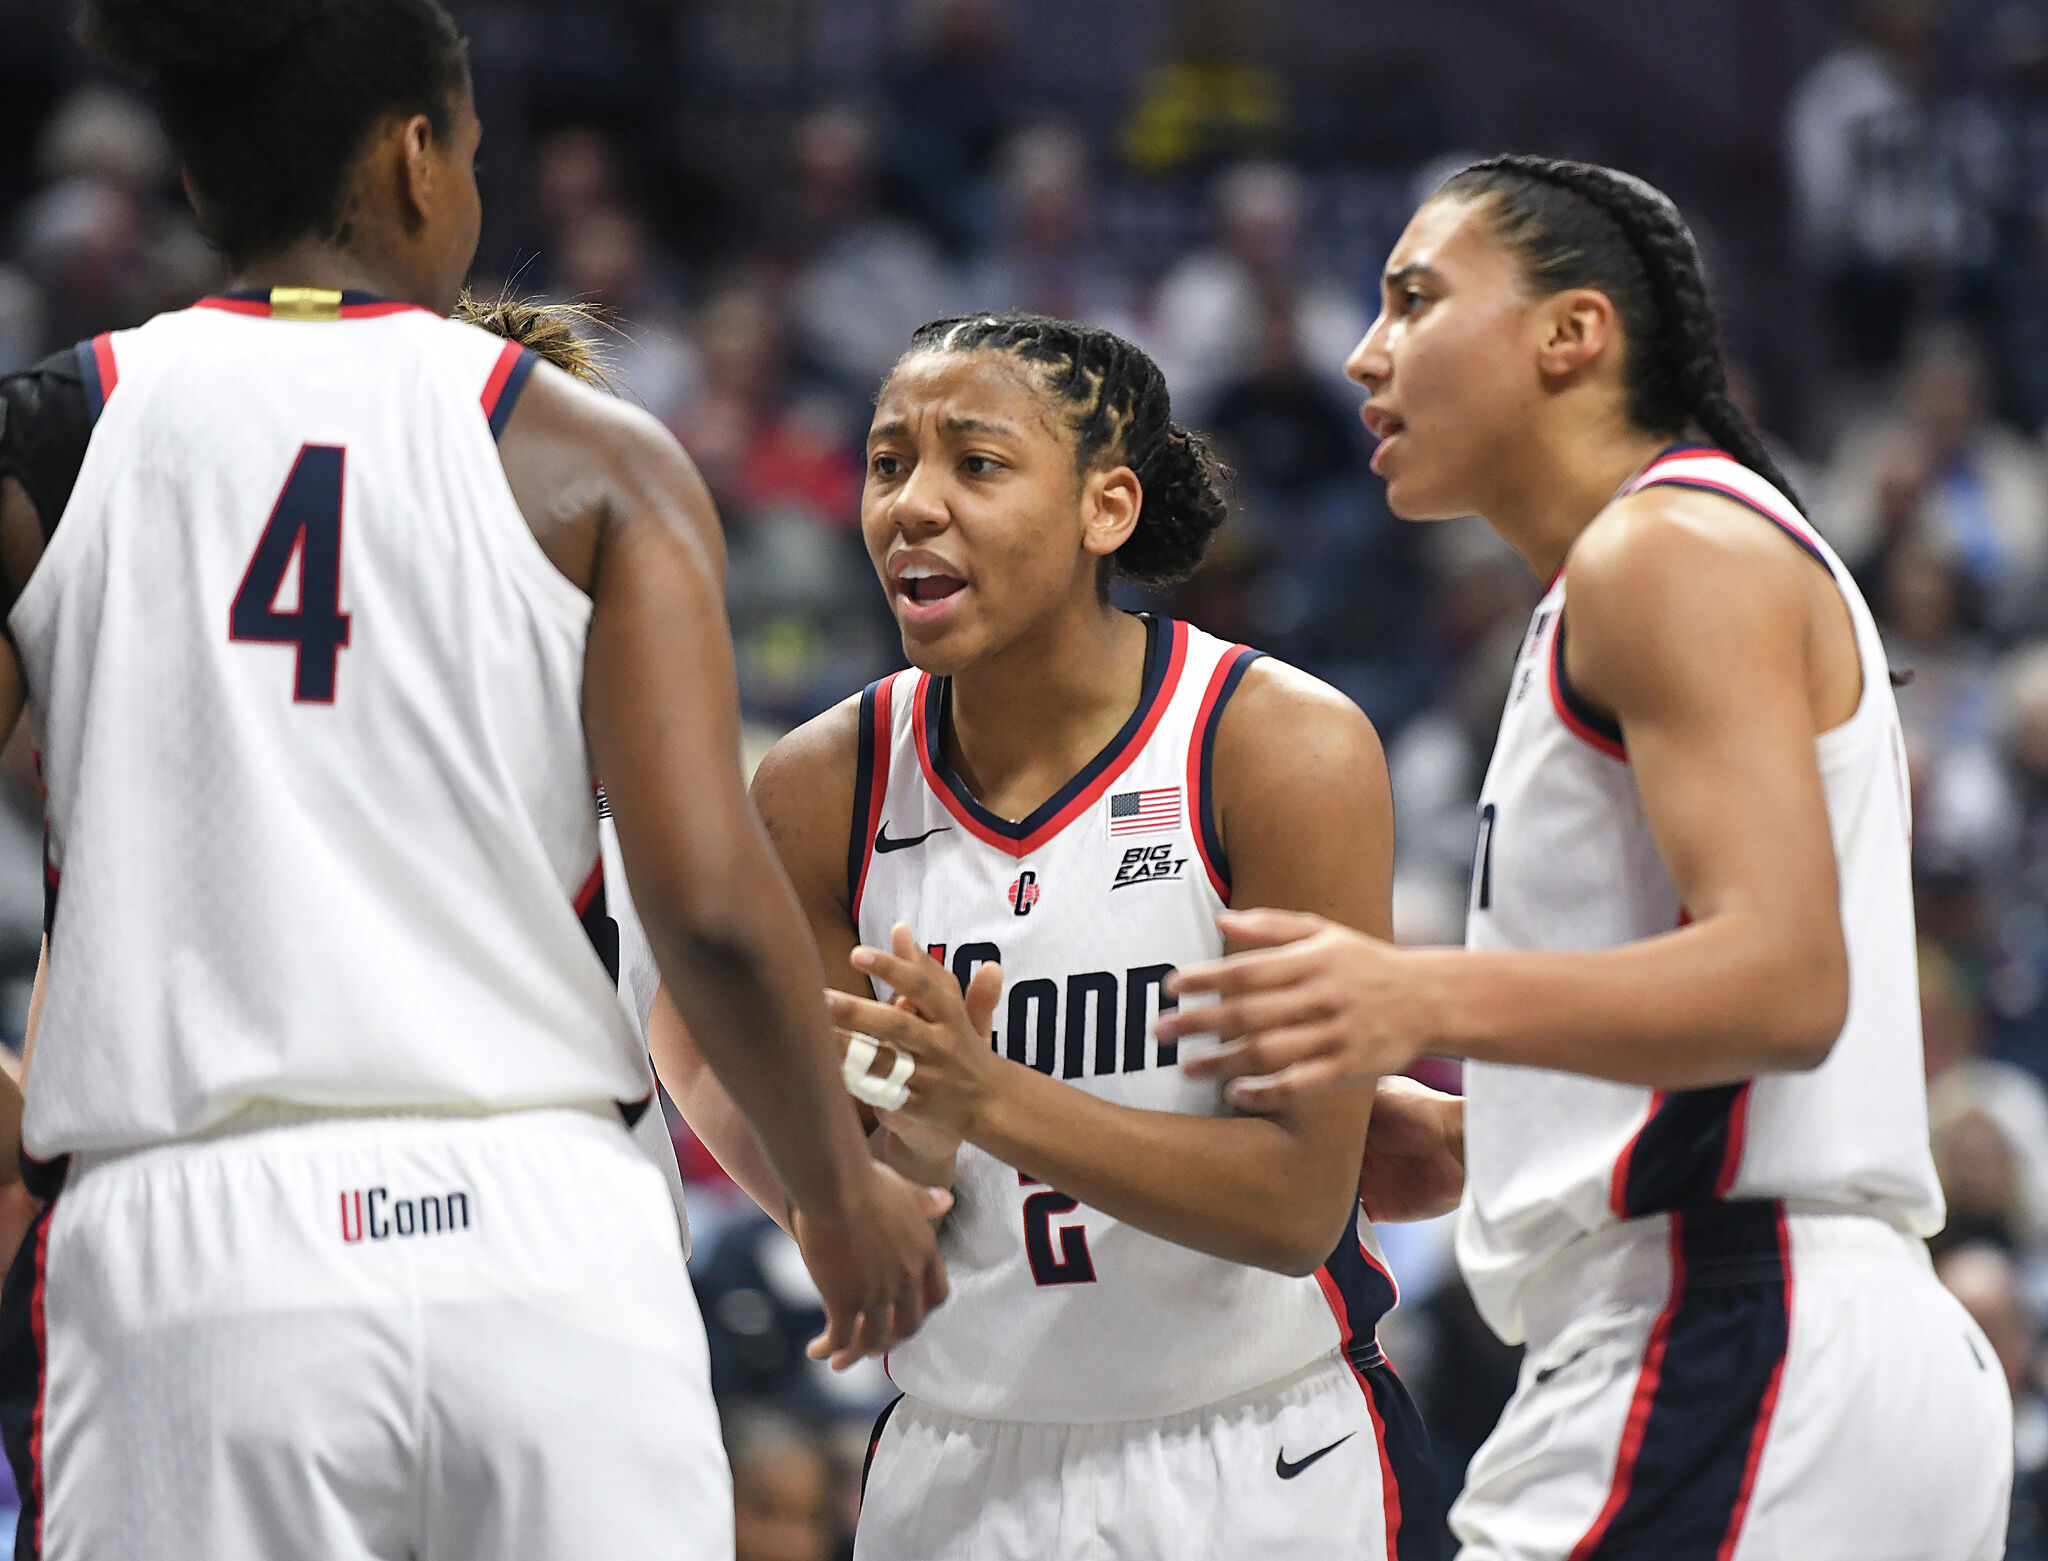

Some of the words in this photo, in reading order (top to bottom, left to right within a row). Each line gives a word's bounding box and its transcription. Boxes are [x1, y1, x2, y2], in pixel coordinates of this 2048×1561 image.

[228, 442, 352, 704] 4
[1114, 858, 1188, 881] EAST
[1121, 843, 1173, 865] BIG
[927, 941, 1179, 1079] onn
[341, 1187, 469, 1243] UConn
